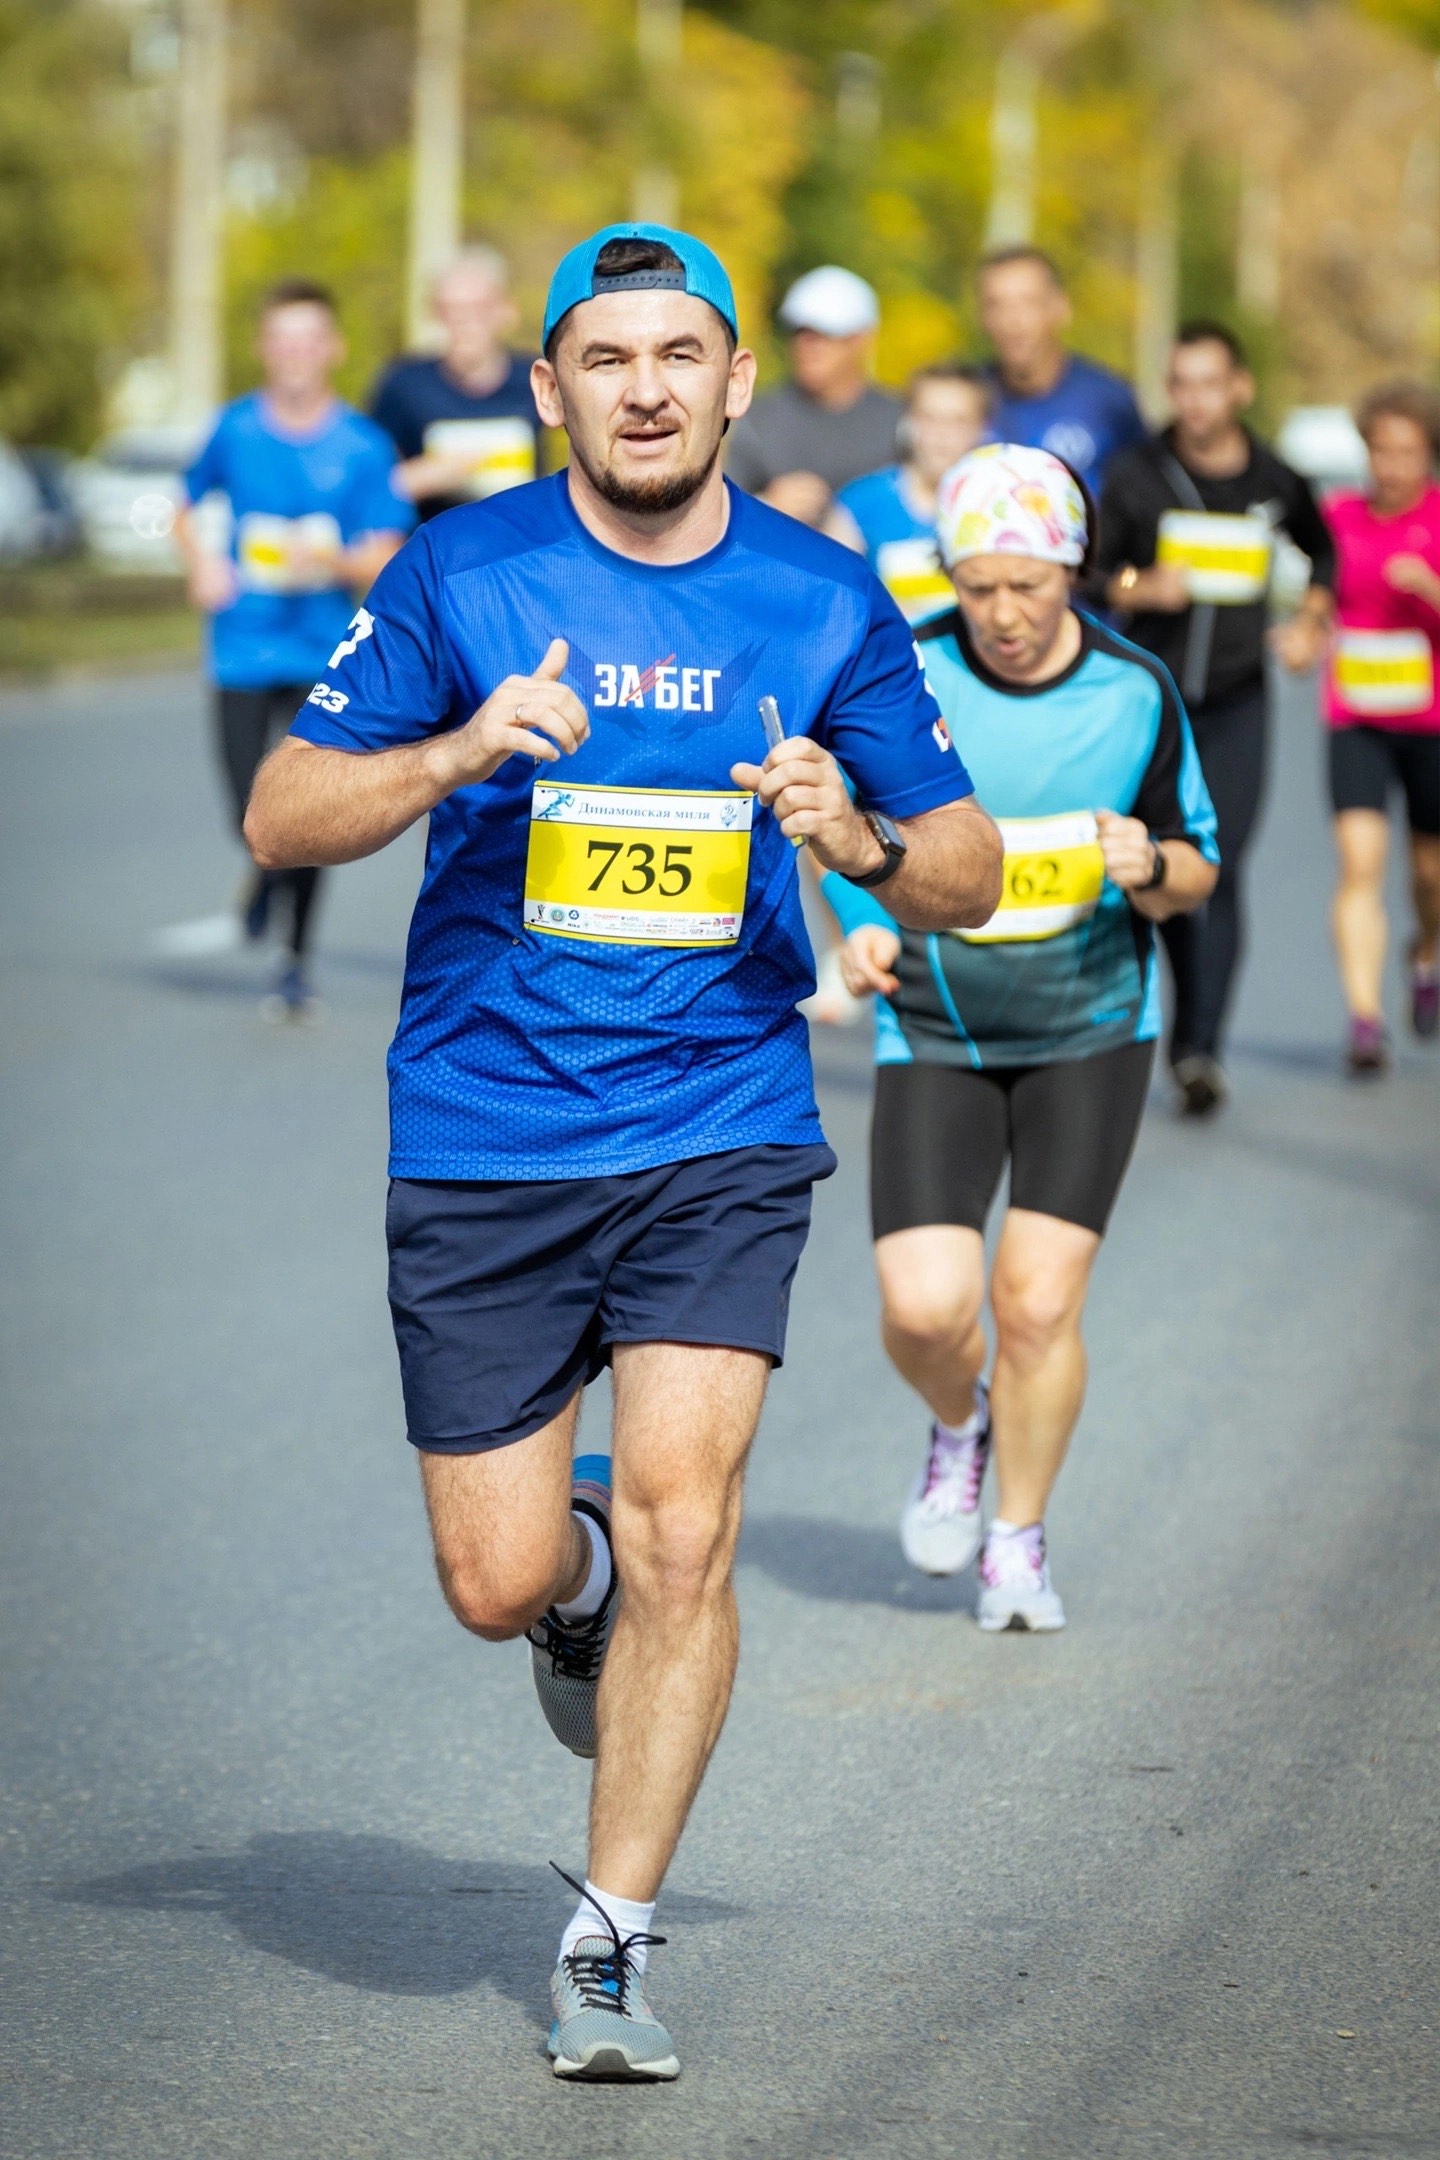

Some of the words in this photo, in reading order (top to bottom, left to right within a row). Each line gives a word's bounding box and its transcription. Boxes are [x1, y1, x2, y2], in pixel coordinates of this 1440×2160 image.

[578, 802, 671, 819] Динамовская
[675, 810, 711, 820] миля
[586, 839, 693, 897] 735
